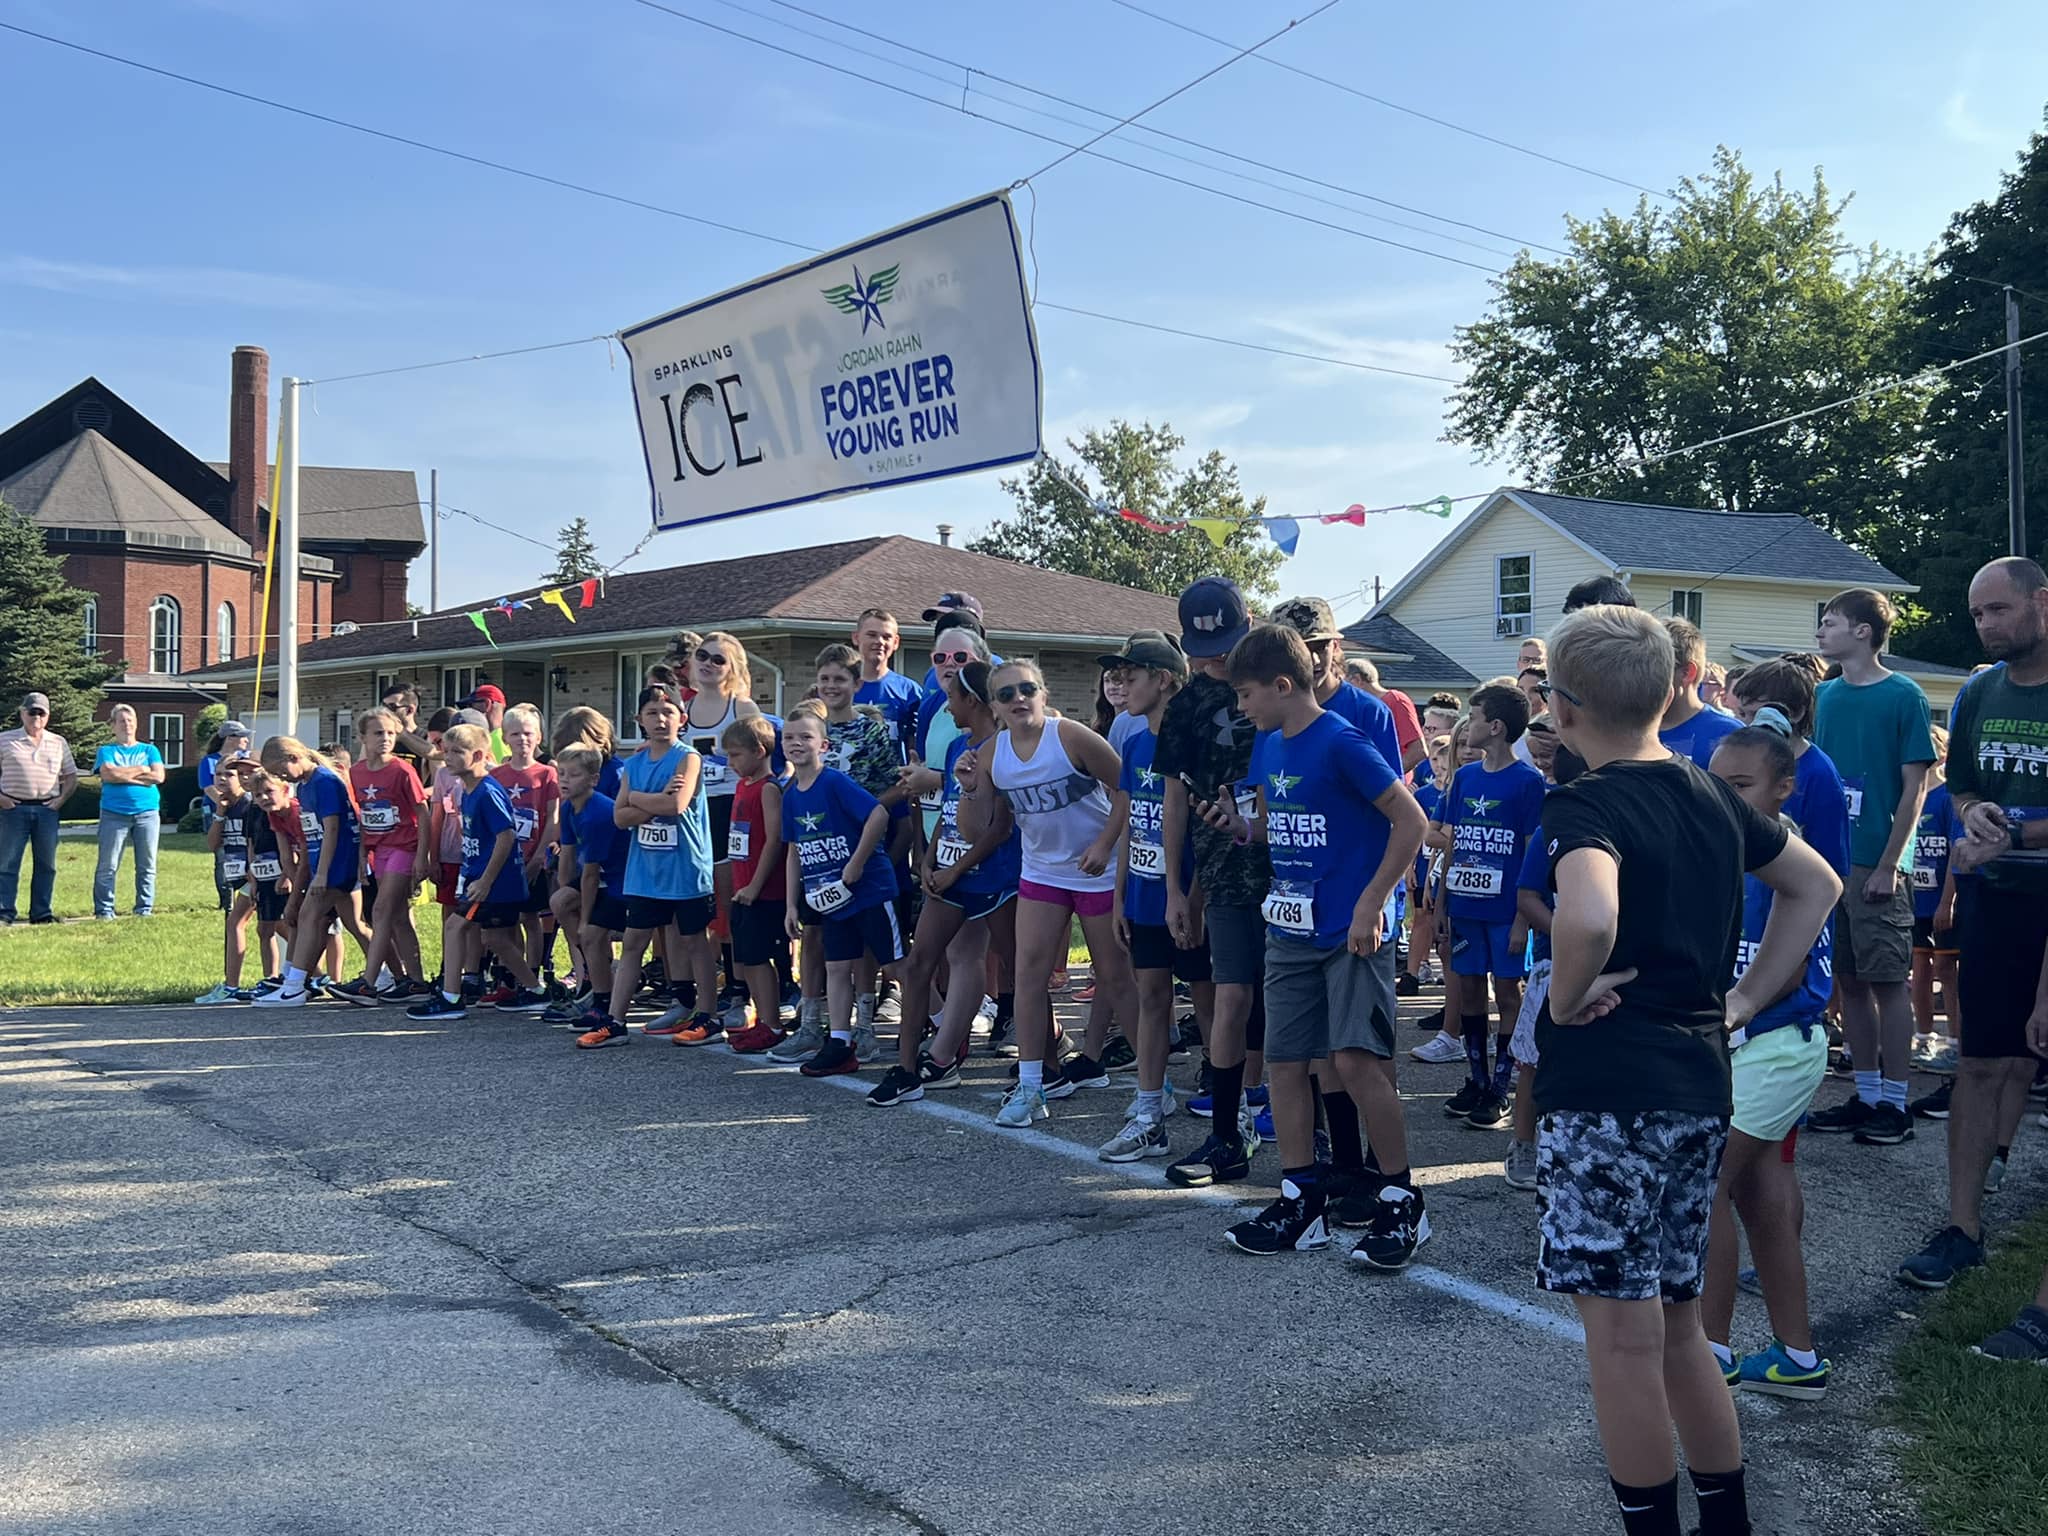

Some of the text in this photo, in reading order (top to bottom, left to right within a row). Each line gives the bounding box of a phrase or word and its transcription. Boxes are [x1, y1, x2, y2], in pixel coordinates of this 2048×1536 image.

[654, 344, 733, 381] SPARKLING
[837, 334, 922, 373] JORDAN RAHN
[820, 354, 956, 426] FOREVER
[660, 374, 763, 482] ICE
[826, 402, 959, 460] YOUNG RUN
[894, 454, 914, 468] MILE
[1978, 757, 2048, 777] TRAC
[1008, 779, 1069, 814] JUST
[641, 827, 668, 842] 7750
[1293, 833, 1327, 847] RUN
[797, 836, 848, 855] OREVER
[1453, 840, 1513, 855] OUNG RUN
[1132, 847, 1157, 868] 652
[254, 863, 275, 875] 7724
[1455, 871, 1492, 889] 7838
[813, 886, 842, 909] 7785
[1269, 900, 1302, 923] 7789
